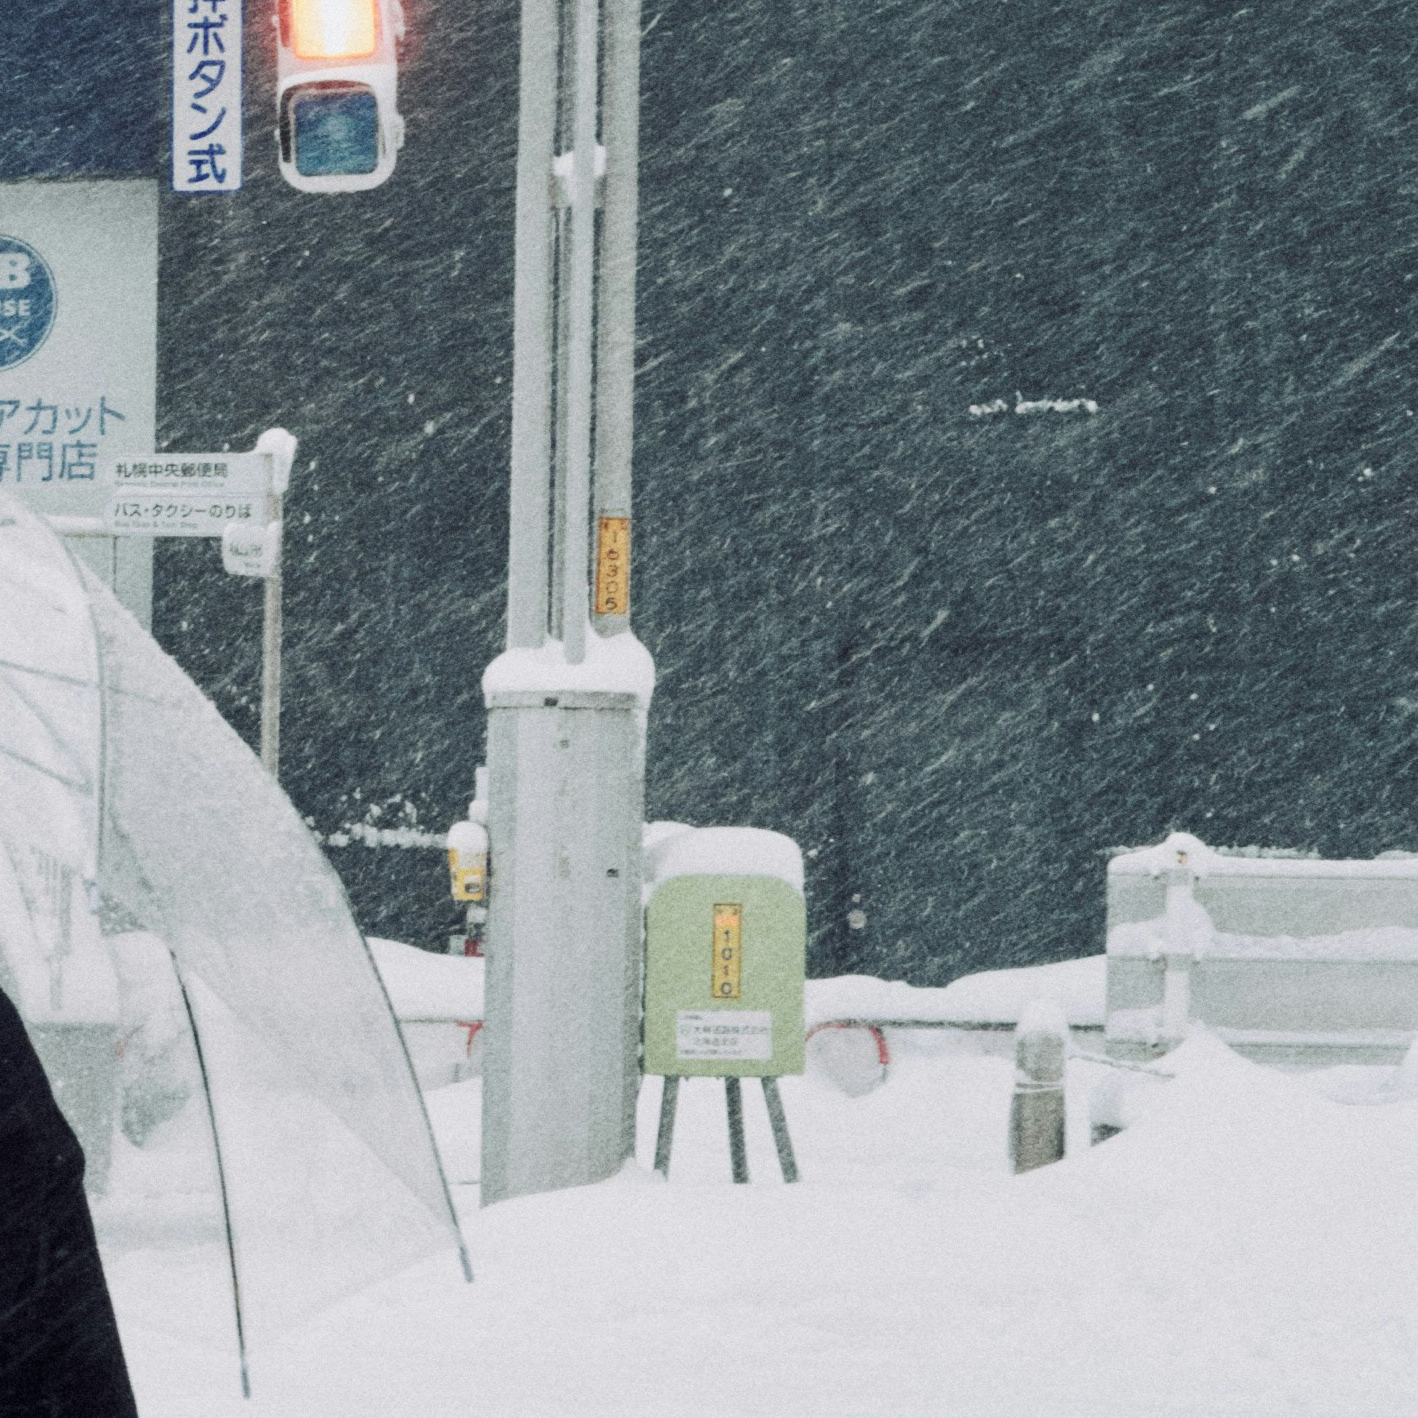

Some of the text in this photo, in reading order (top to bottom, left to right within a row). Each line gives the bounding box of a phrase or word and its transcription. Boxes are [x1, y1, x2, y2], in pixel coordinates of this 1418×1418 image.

[114, 503, 252, 519] バス・タクシーのりば
